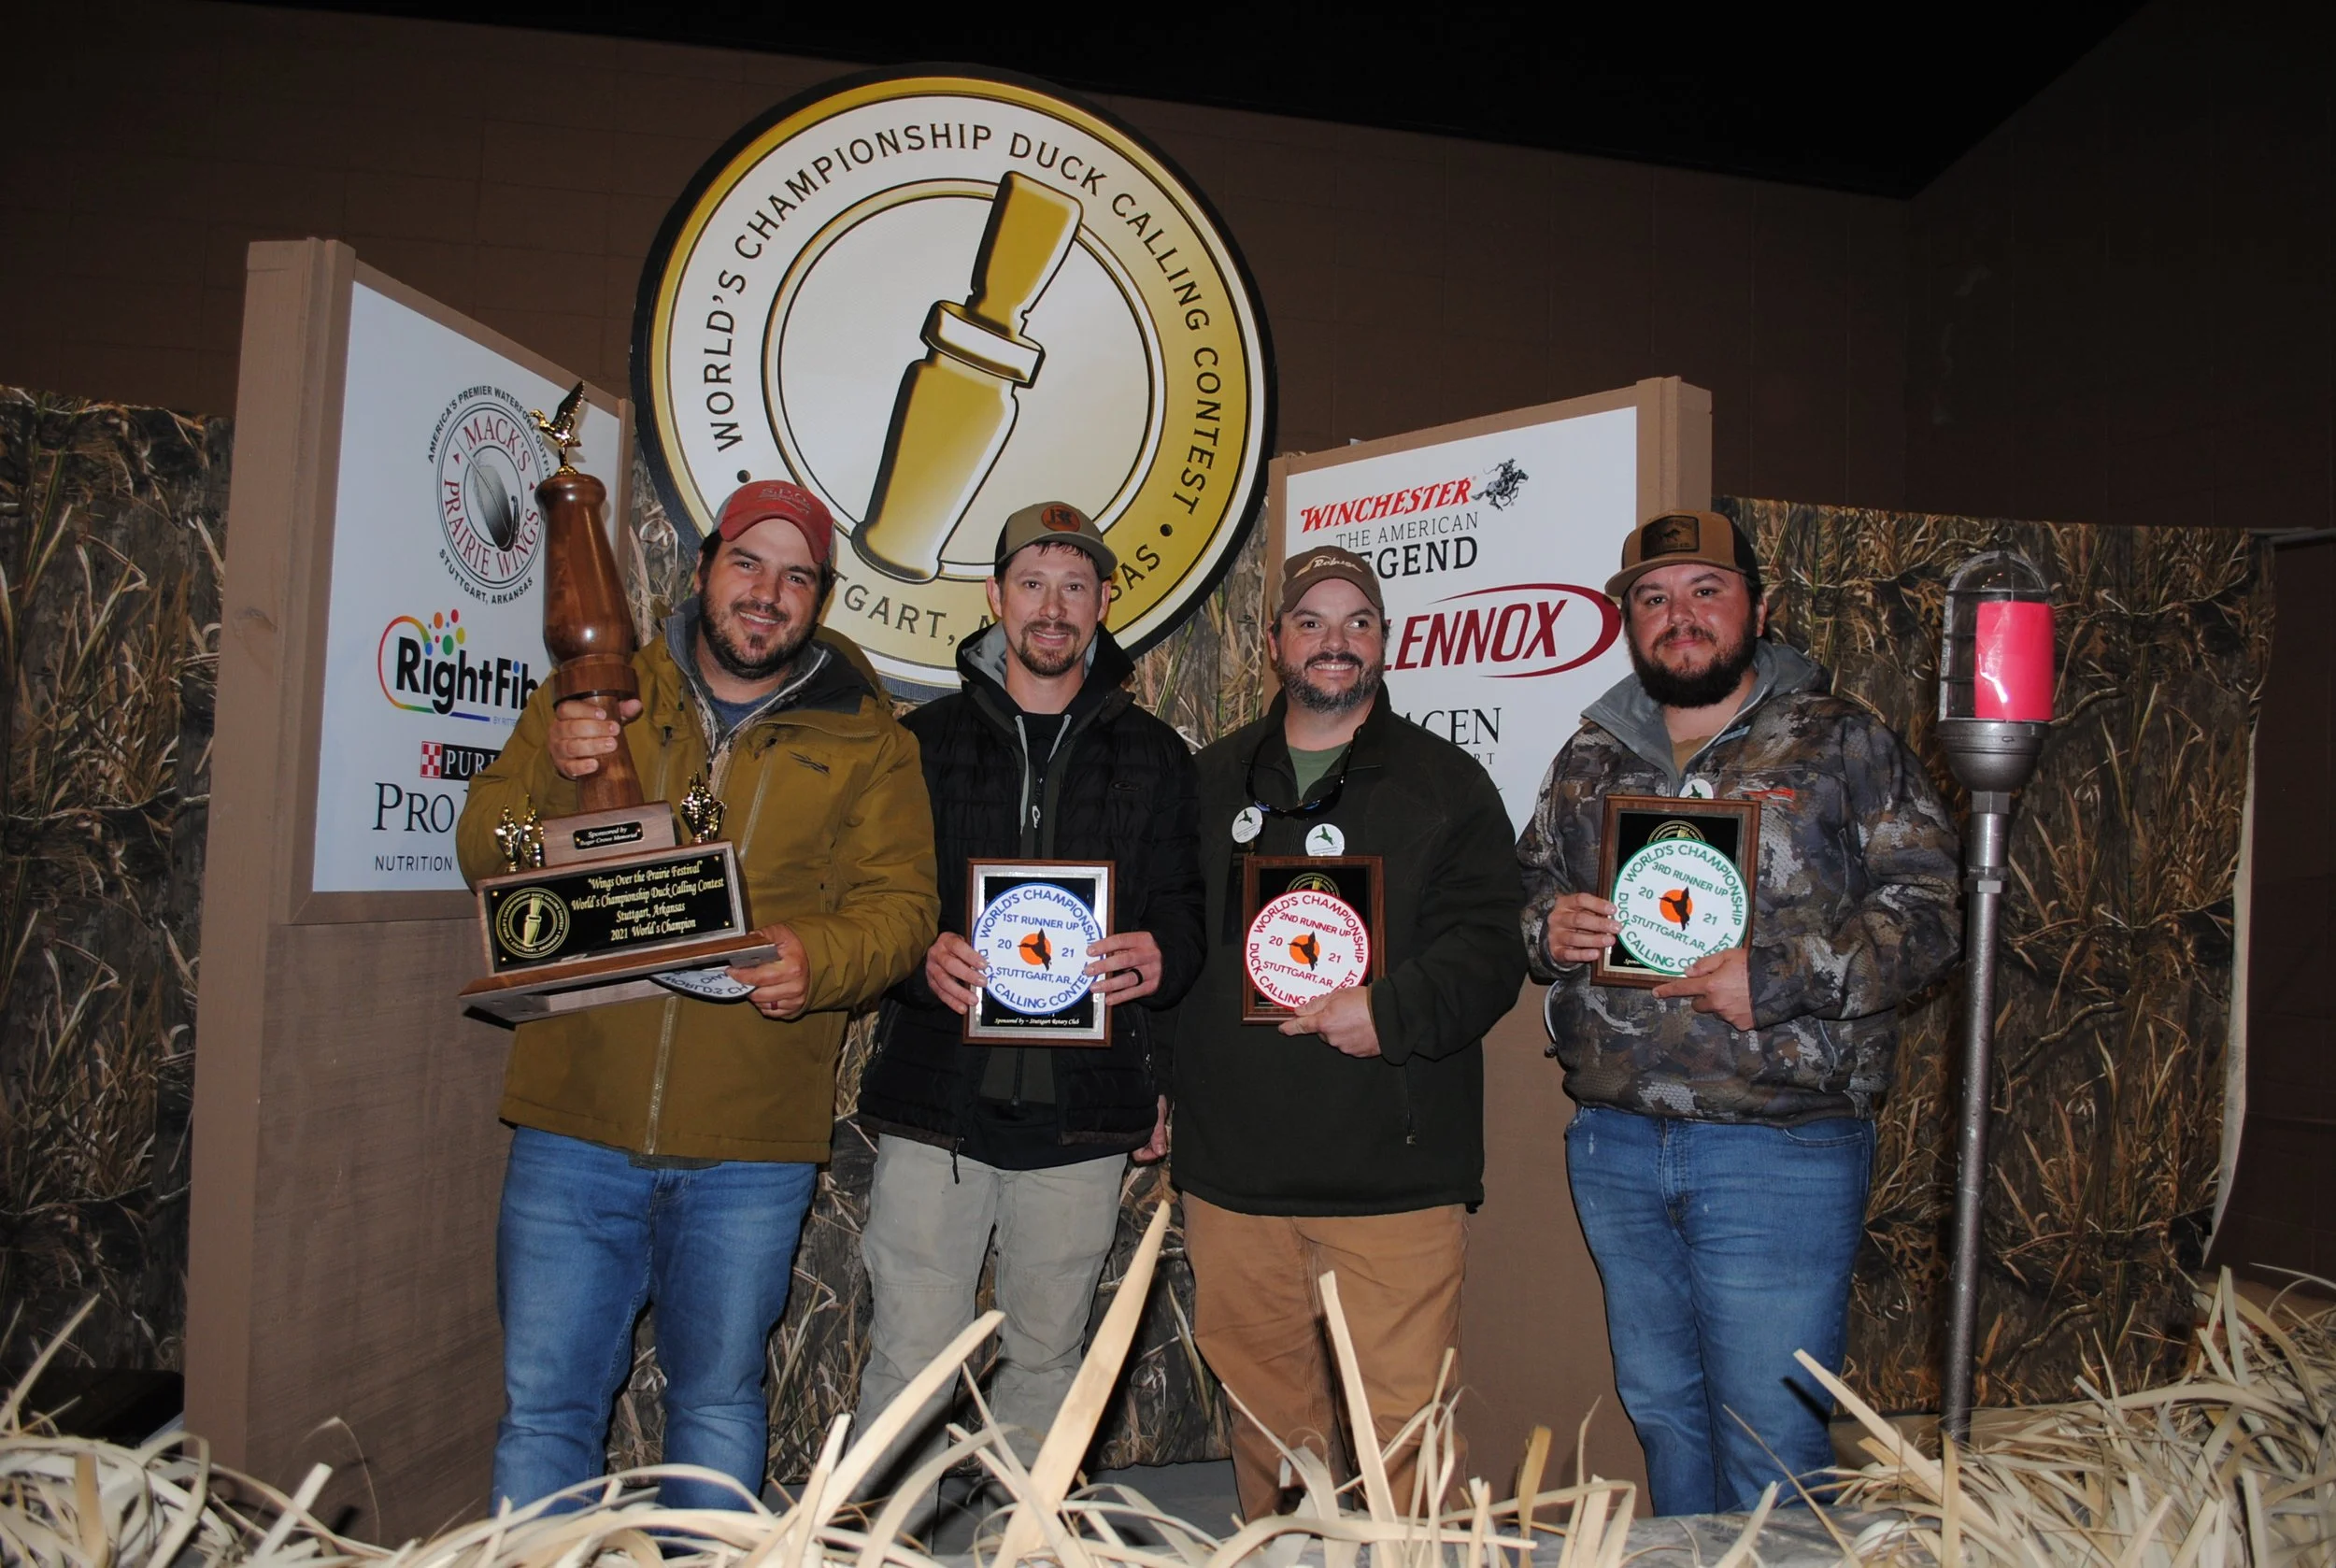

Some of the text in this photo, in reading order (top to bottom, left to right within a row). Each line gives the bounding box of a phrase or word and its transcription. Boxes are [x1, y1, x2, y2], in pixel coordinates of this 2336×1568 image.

[704, 122, 1221, 515] WORLD'S CHAMPIONSHIP DUCK CALLING CONTEST
[428, 399, 458, 464] AMERICA'S
[458, 385, 492, 405] PREMIER
[463, 414, 532, 472] MACK'S
[444, 478, 540, 578] PRAIRIE WINGS
[1300, 477, 1473, 534] WINCHESTER
[1335, 511, 1478, 549] THE AMERICAN
[439, 549, 534, 606] STUTTGART, ARKANSAS
[1358, 535, 1478, 579] GEND
[833, 570, 955, 646] GART,
[396, 635, 539, 715] RightFib
[445, 749, 499, 776] PUR
[375, 855, 453, 872] NUTRITION
[616, 875, 633, 887] Over
[634, 870, 645, 882] the
[646, 867, 670, 881] Prairie
[1623, 844, 1743, 926] WORLD'S CHAMPIONSHIP
[1652, 862, 1729, 897] 3RD RUNNER UP
[601, 888, 649, 908] Championship
[650, 886, 672, 899] Duck
[671, 880, 697, 896] Calling
[698, 877, 724, 892] Contest
[616, 902, 685, 923] Stuttgart, Arkansas
[979, 889, 1096, 945] WORLD'S CHAMPIONSHI
[1638, 886, 1717, 926] 20 21
[610, 928, 628, 941] 2021
[661, 917, 696, 934] Champion
[1003, 913, 1079, 931] 1ST RUNNER UP
[1253, 894, 1364, 963] WORLD'S CHAMPIONSHIP
[1279, 911, 1352, 939] 2ND RUNNER UP
[1618, 891, 1632, 930] DUCK
[1626, 931, 1675, 968] CALLING
[997, 938, 1075, 958] 20 21
[1268, 934, 1342, 964] 20 21
[978, 948, 997, 984] DCK
[994, 983, 1047, 1009] CALLING
[1249, 942, 1307, 1006] DUCK CALLING
